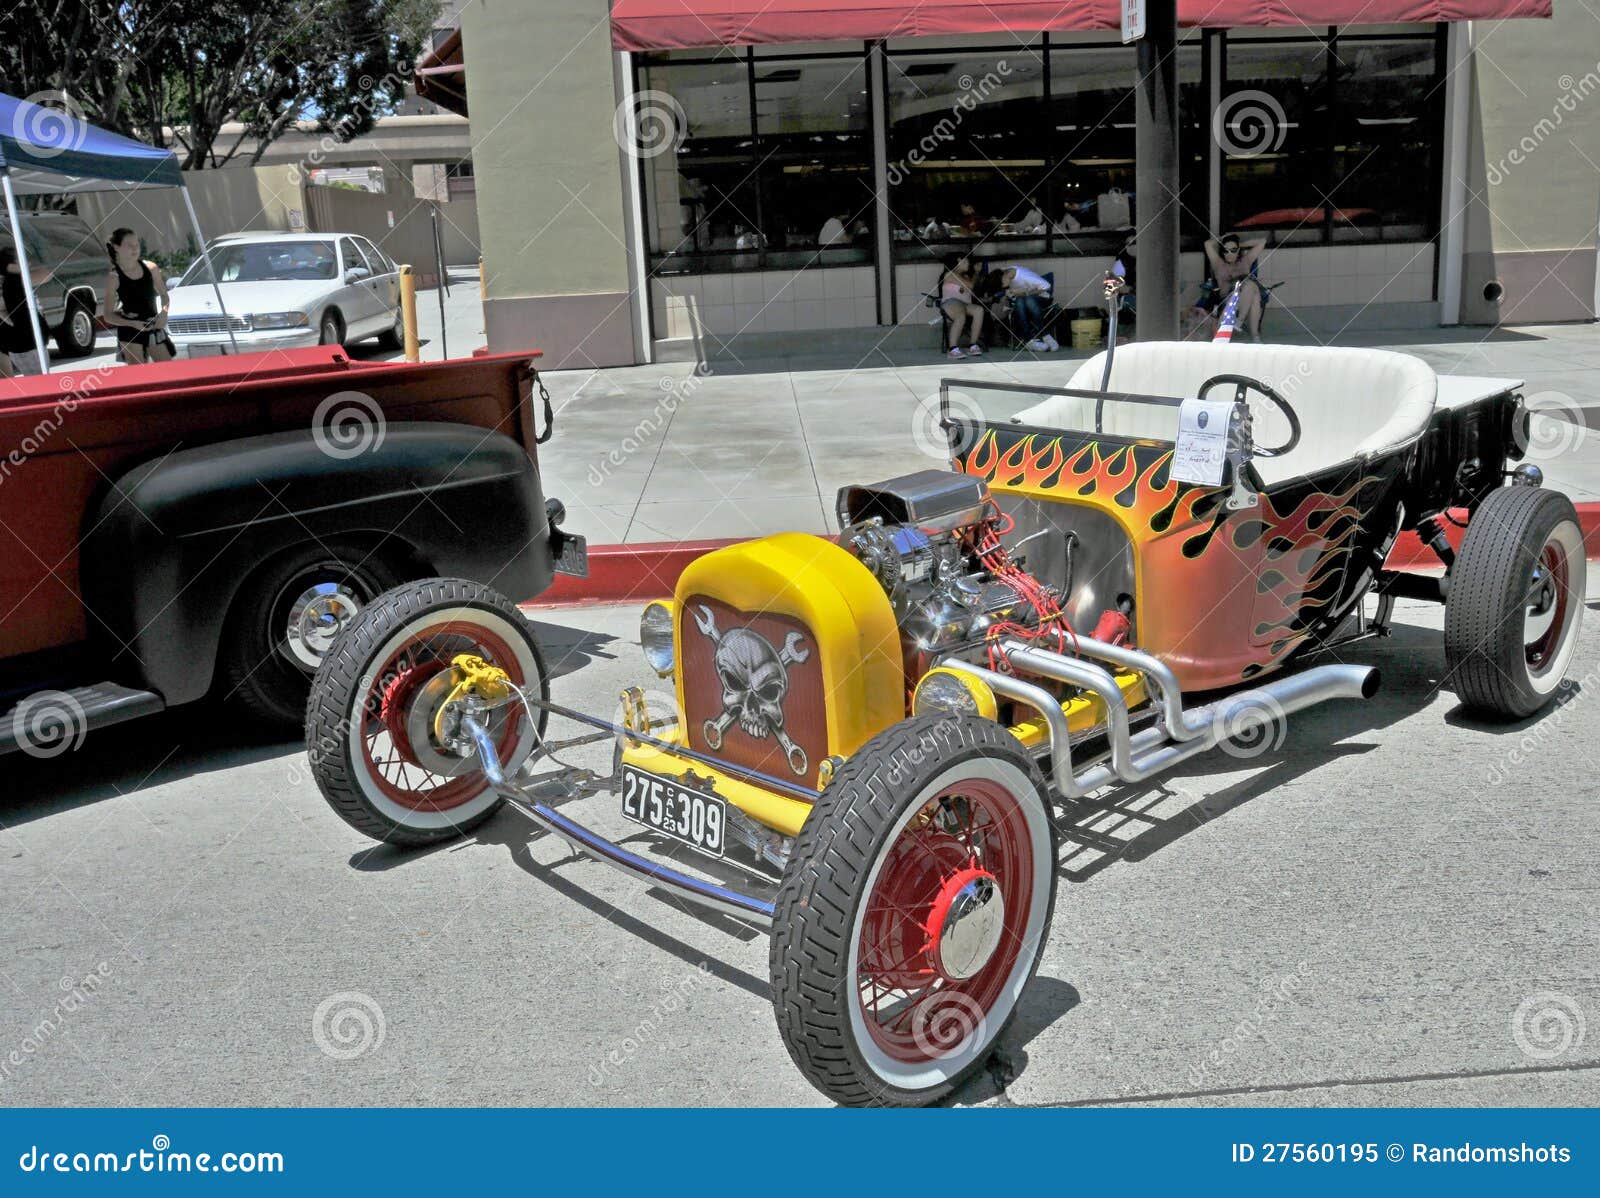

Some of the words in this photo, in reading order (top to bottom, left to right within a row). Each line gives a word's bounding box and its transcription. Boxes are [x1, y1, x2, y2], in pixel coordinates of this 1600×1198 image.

[624, 771, 663, 826] 275
[665, 787, 675, 818] CAL
[677, 792, 721, 849] 309
[663, 816, 676, 832] 23
